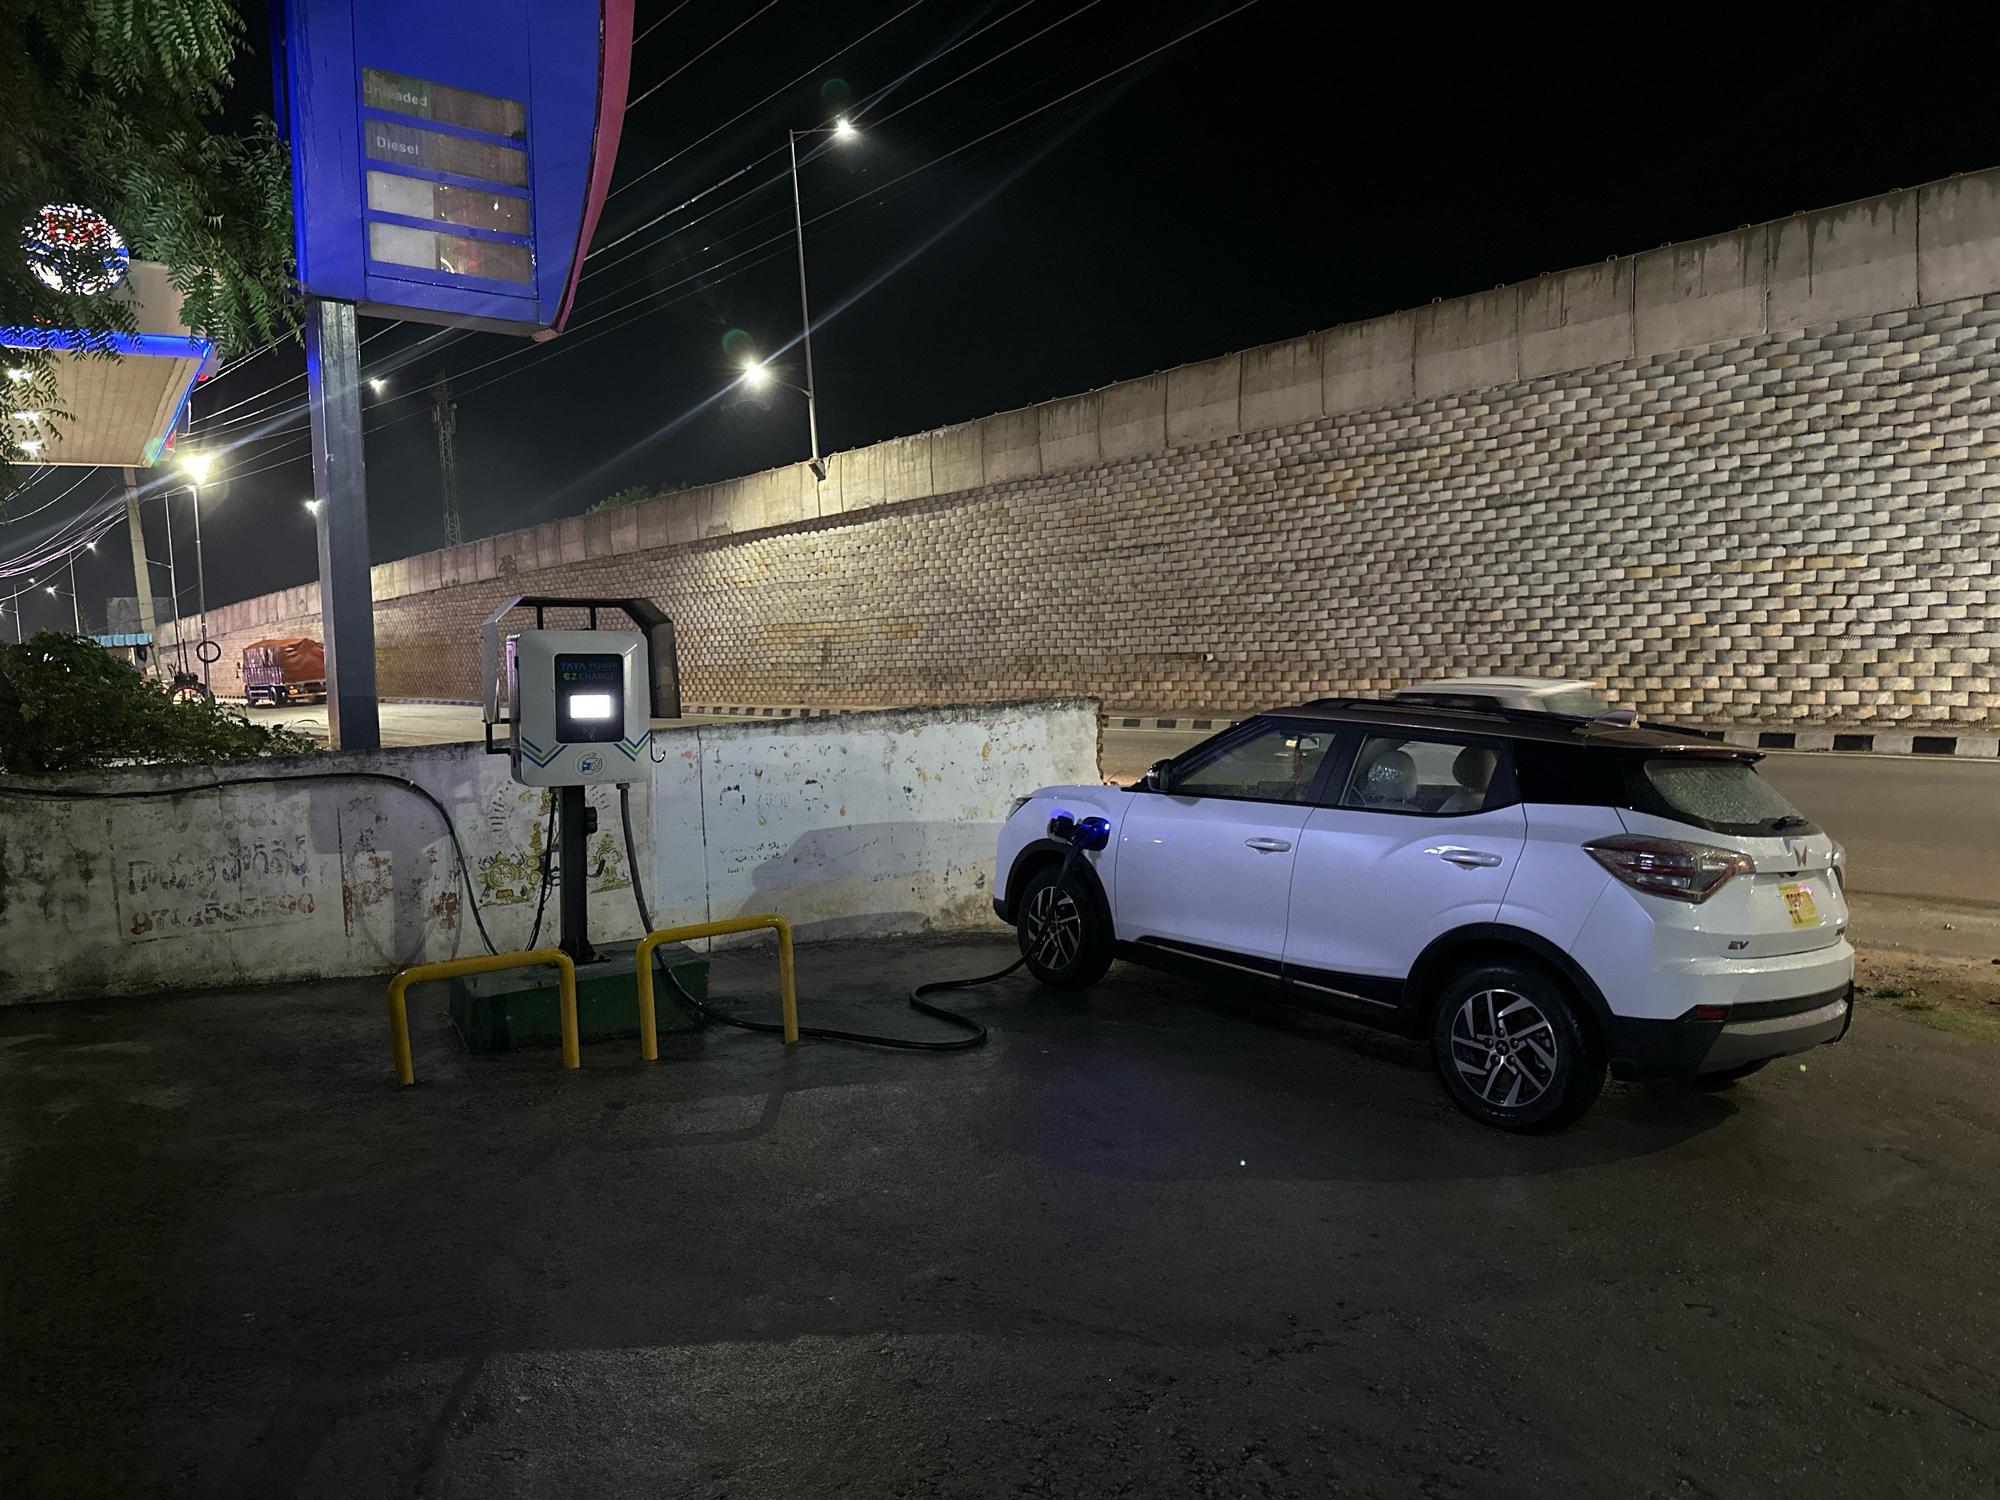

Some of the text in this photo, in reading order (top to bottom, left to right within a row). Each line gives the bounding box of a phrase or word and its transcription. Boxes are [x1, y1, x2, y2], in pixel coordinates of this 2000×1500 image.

[364, 81, 428, 107] Unaded
[376, 136, 420, 156] Diesel
[560, 662, 618, 670] TATA POWER
[578, 672, 616, 681] CHARGE
[1727, 940, 1750, 951] EV
